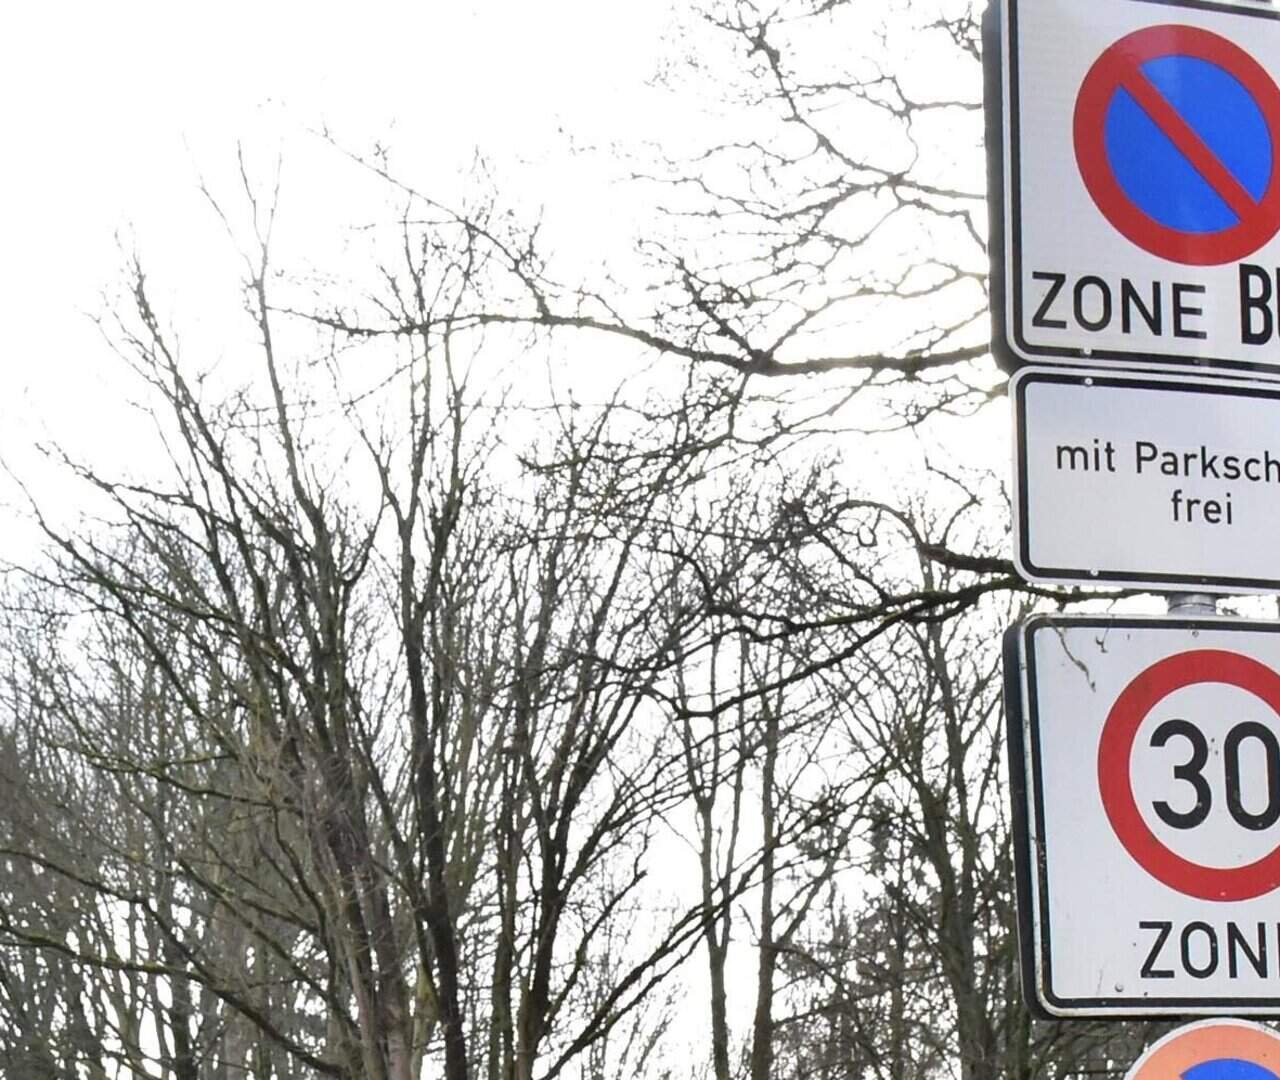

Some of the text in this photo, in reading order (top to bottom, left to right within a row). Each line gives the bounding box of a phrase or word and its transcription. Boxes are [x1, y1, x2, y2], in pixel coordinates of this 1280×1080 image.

[1032, 271, 1207, 339] ZONE
[1056, 439, 1116, 472] mit
[1171, 489, 1232, 524] frei
